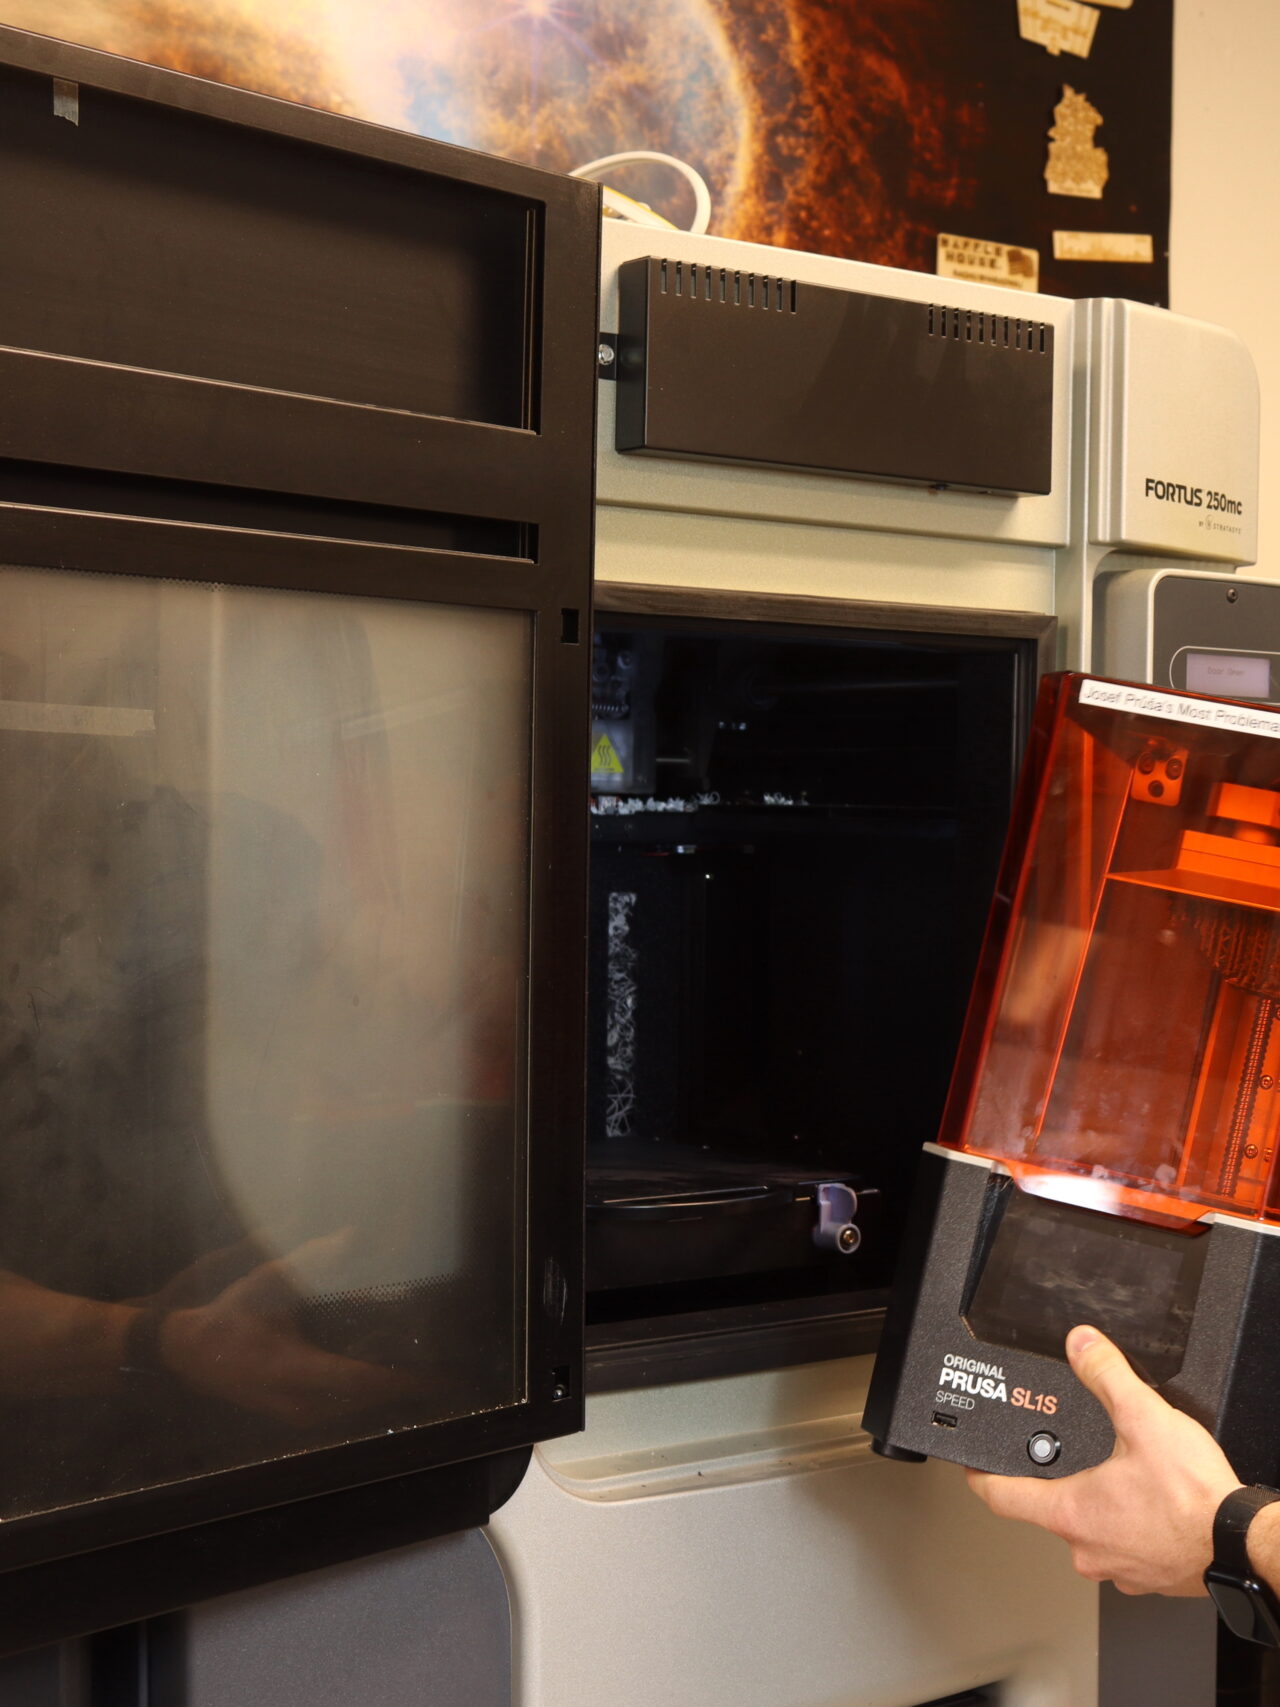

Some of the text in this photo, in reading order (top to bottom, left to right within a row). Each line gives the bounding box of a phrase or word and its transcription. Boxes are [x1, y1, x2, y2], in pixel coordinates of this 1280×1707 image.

[941, 237, 1002, 257] WAFFLE
[945, 251, 998, 269] HOUSE
[1145, 477, 1242, 515] FORTUS 250mc
[1085, 687, 1122, 703] Josef
[1177, 702, 1212, 720] Most
[944, 1353, 1006, 1380] ORIGINAL
[935, 1390, 975, 1411] SPEED
[939, 1367, 1058, 1415] PRUSA SL1S
